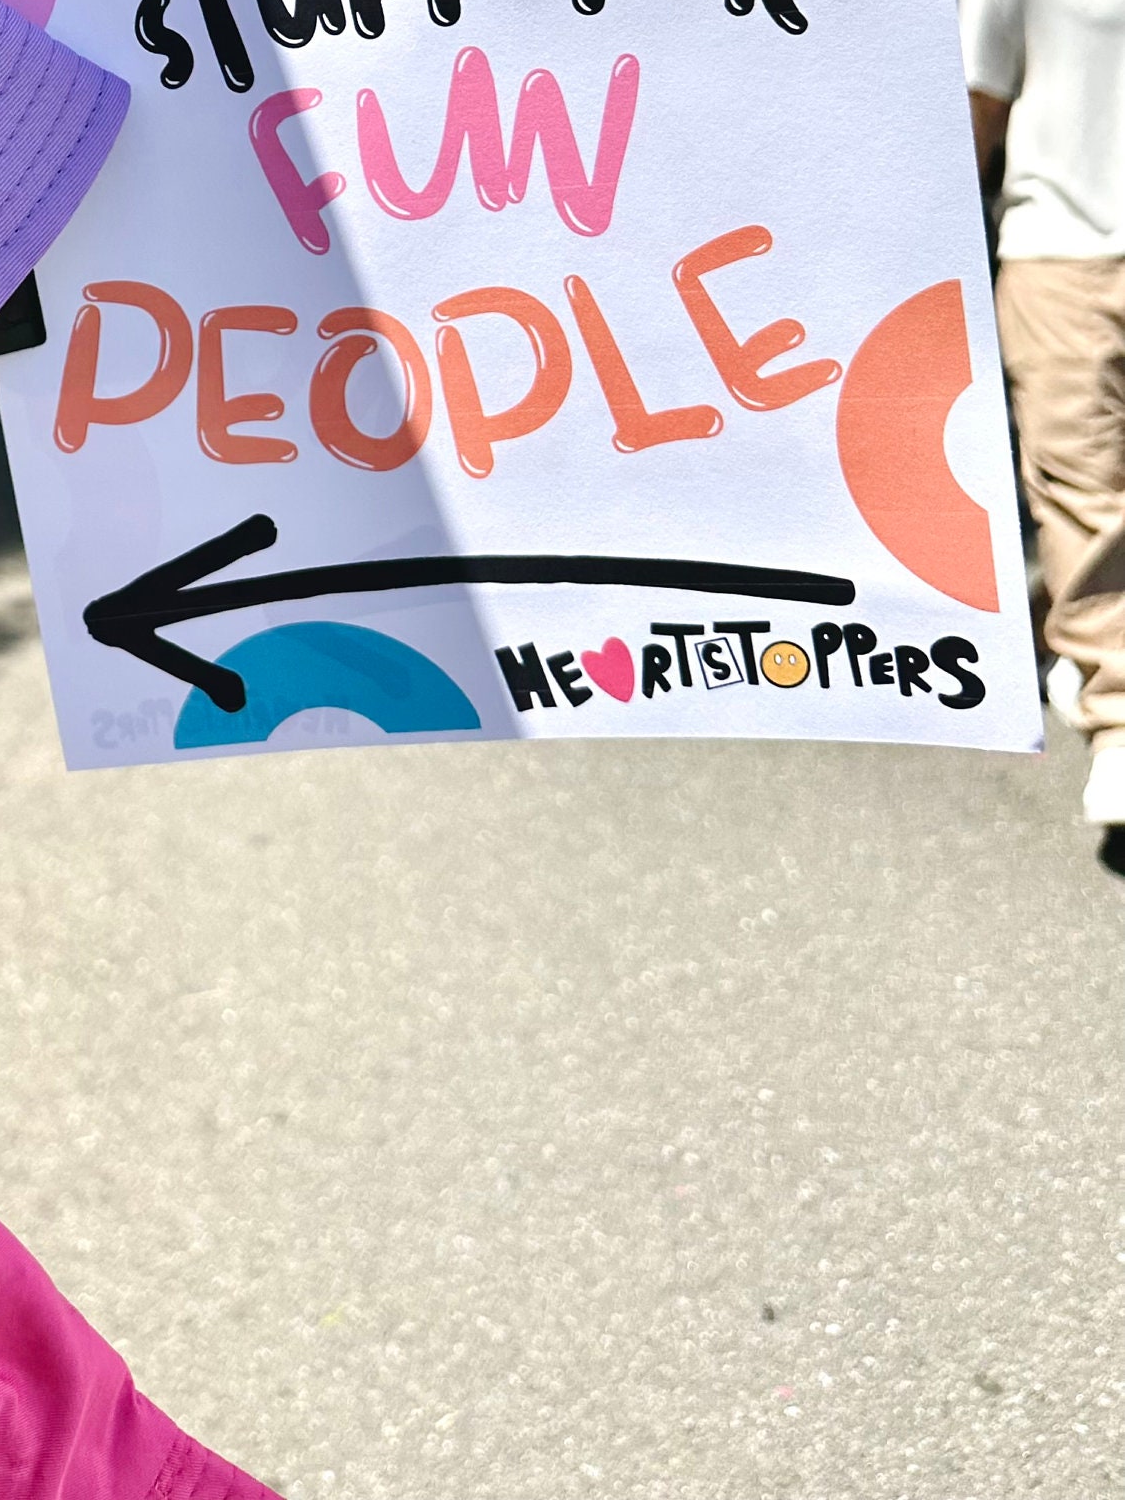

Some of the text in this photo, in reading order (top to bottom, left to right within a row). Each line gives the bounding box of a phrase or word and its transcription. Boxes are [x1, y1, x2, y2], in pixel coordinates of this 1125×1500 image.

[248, 46, 641, 256] FUN
[54, 225, 843, 479] PEOPLE
[495, 621, 986, 712] HERTSTOPPERS
